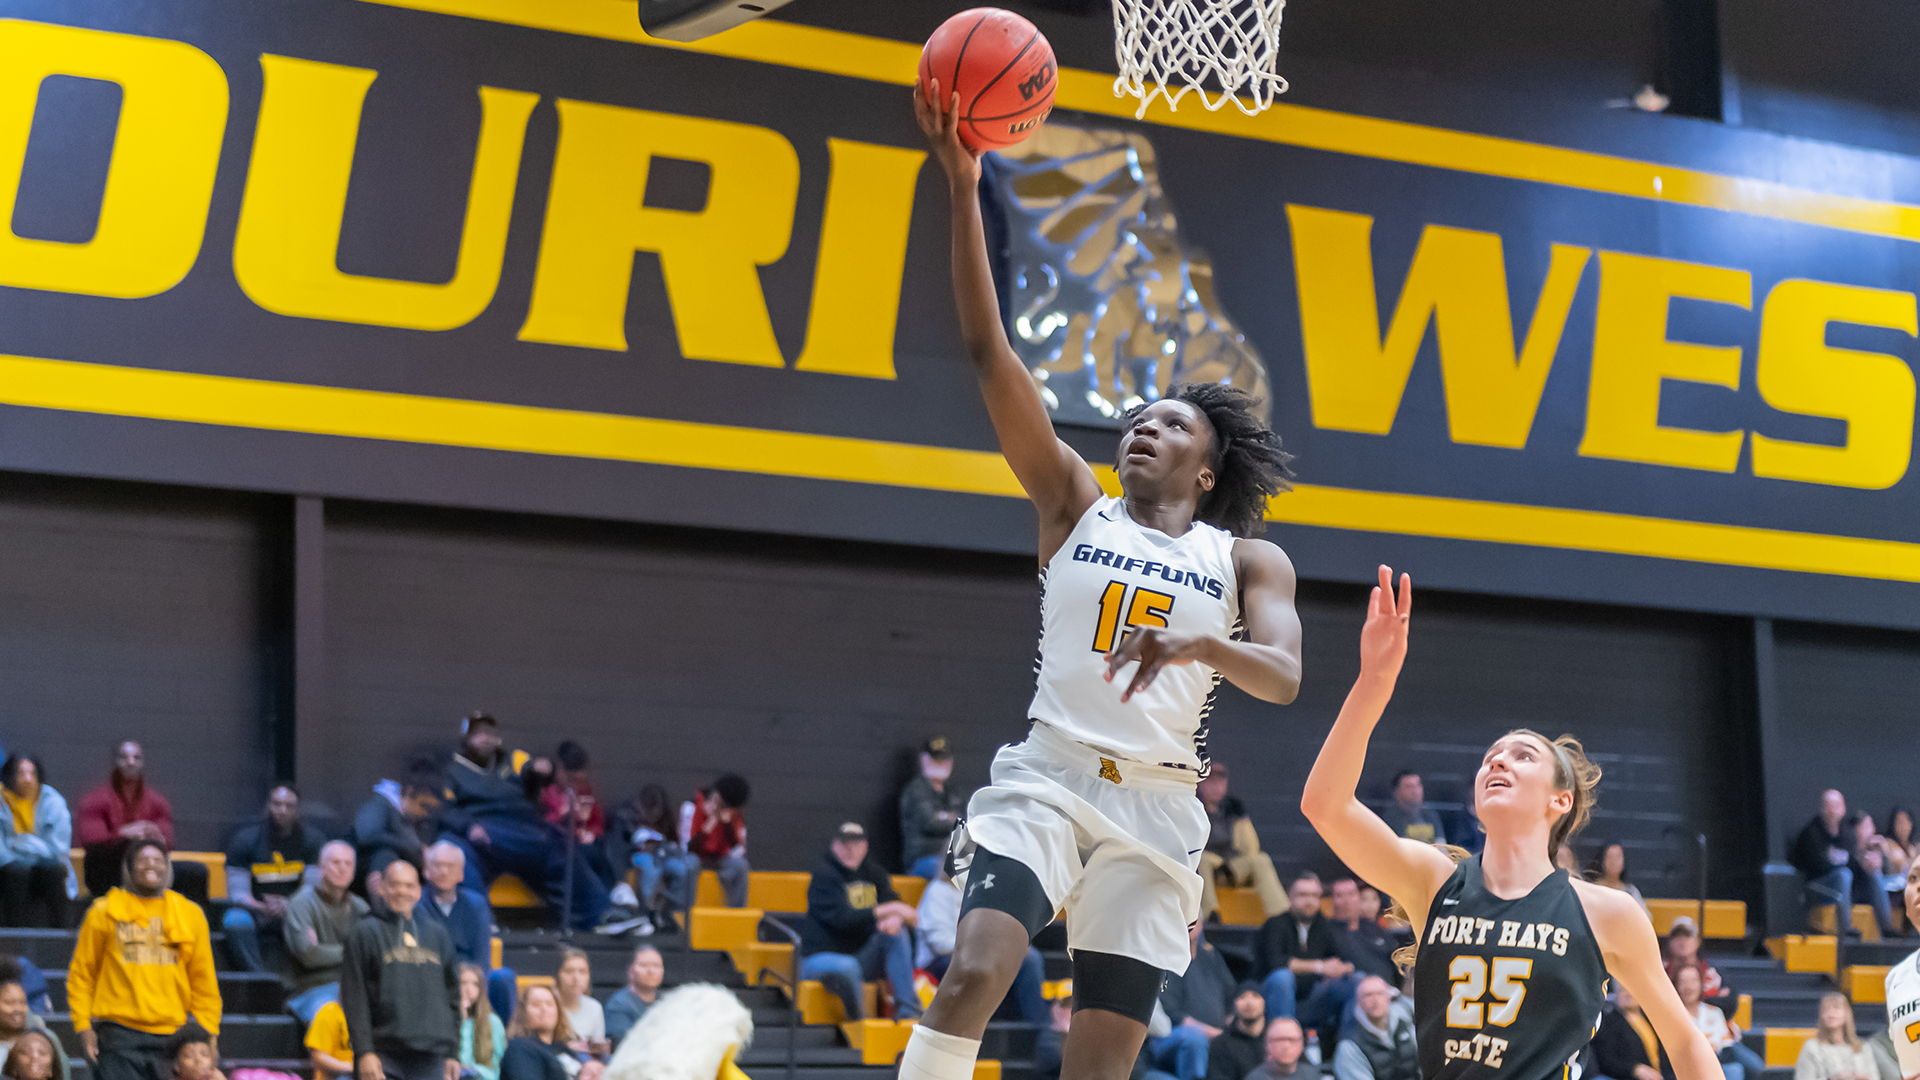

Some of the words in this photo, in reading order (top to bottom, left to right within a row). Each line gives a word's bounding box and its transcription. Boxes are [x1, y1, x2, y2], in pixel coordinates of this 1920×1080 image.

[1286, 203, 1918, 491] WES
[1072, 543, 1225, 600] GRIFFONS
[1091, 579, 1176, 654] 15
[1427, 914, 1496, 946] FORT
[1497, 920, 1571, 957] HAYS
[1446, 955, 1534, 1030] 25
